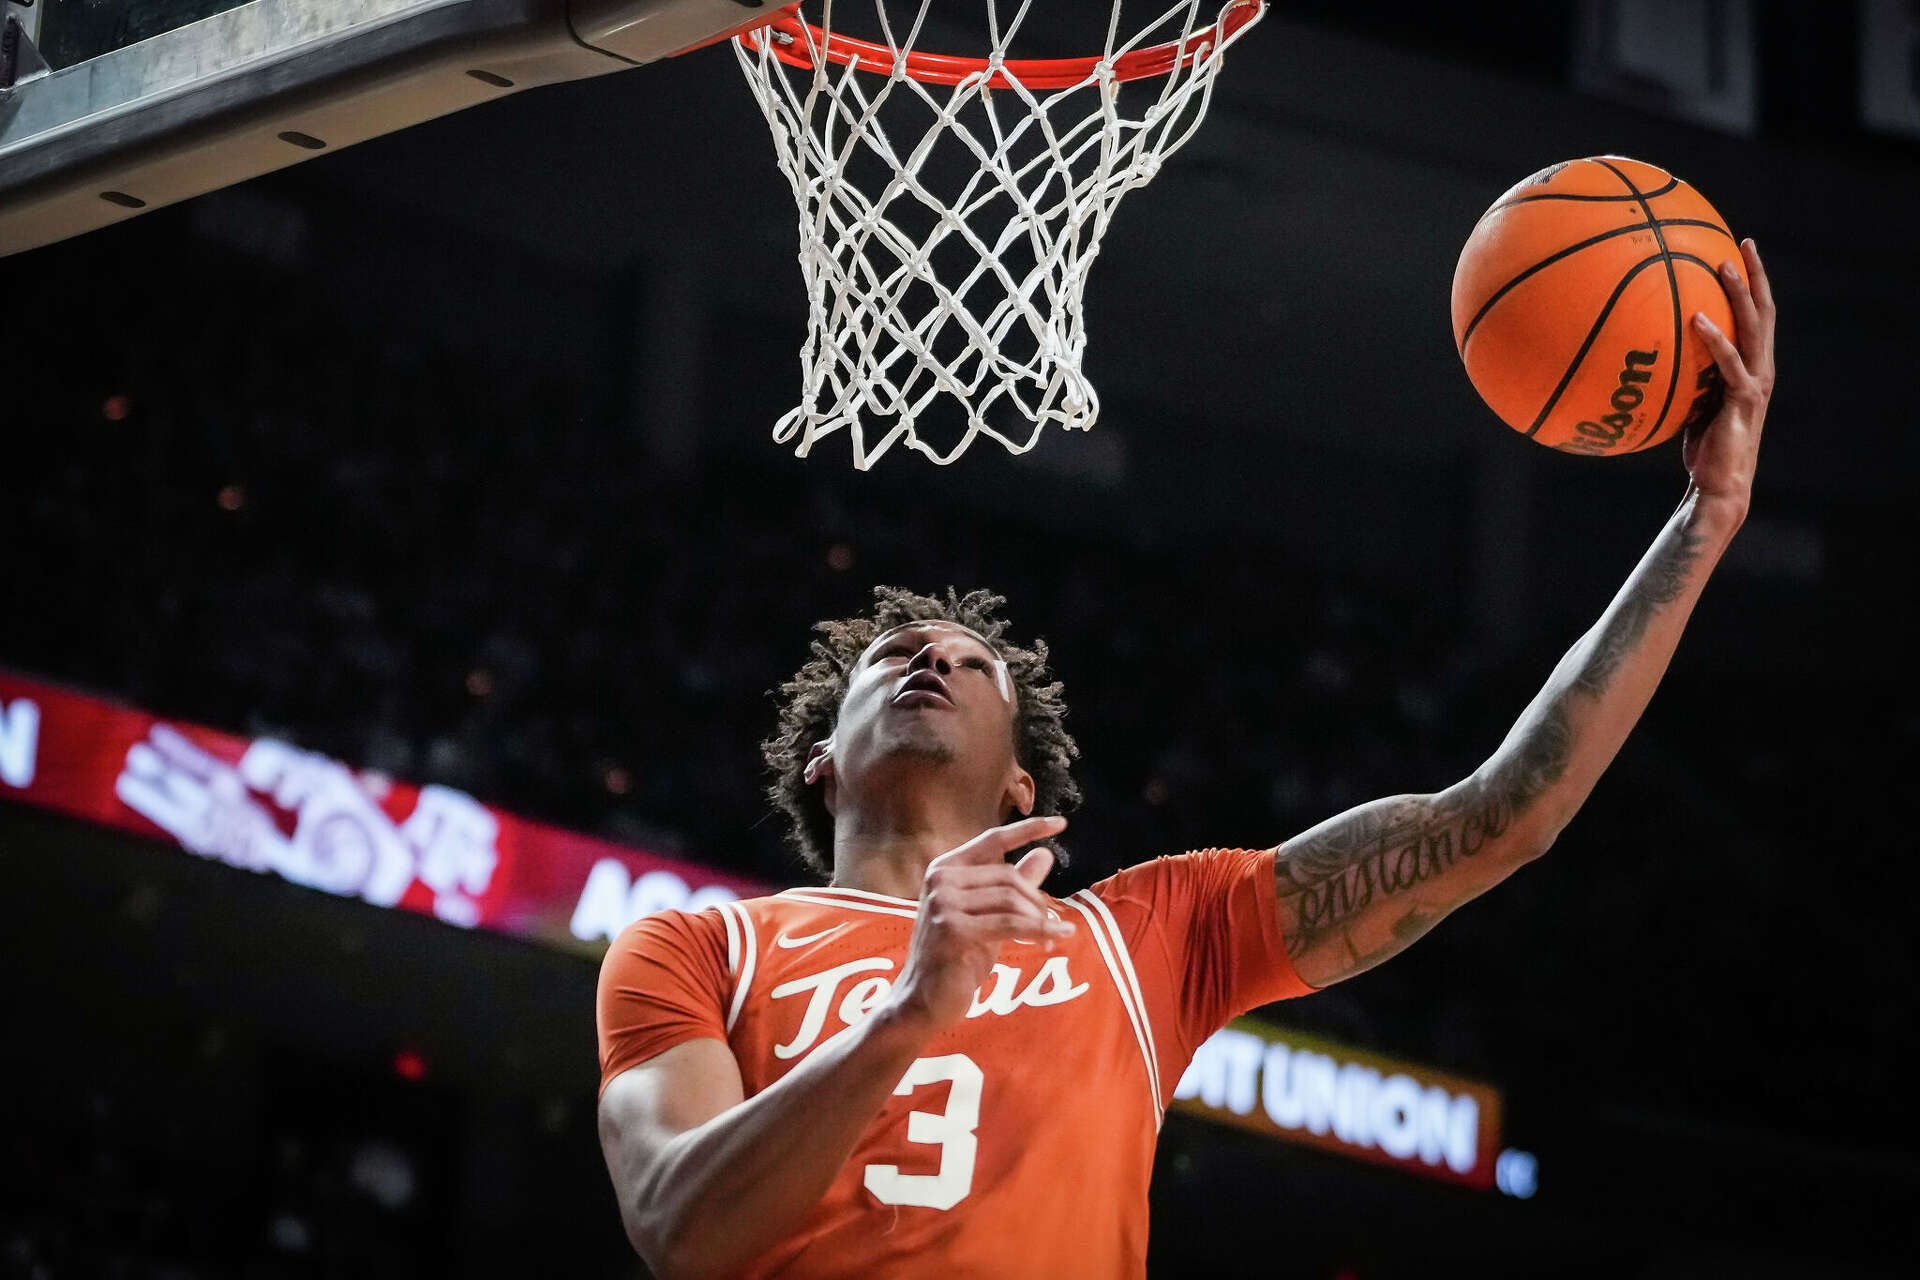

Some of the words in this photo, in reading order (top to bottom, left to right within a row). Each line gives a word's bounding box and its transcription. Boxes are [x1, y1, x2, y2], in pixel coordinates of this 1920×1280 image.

[772, 956, 1090, 1060] Teas
[864, 1053, 984, 1211] 3
[1263, 1042, 1479, 1175] UNION
